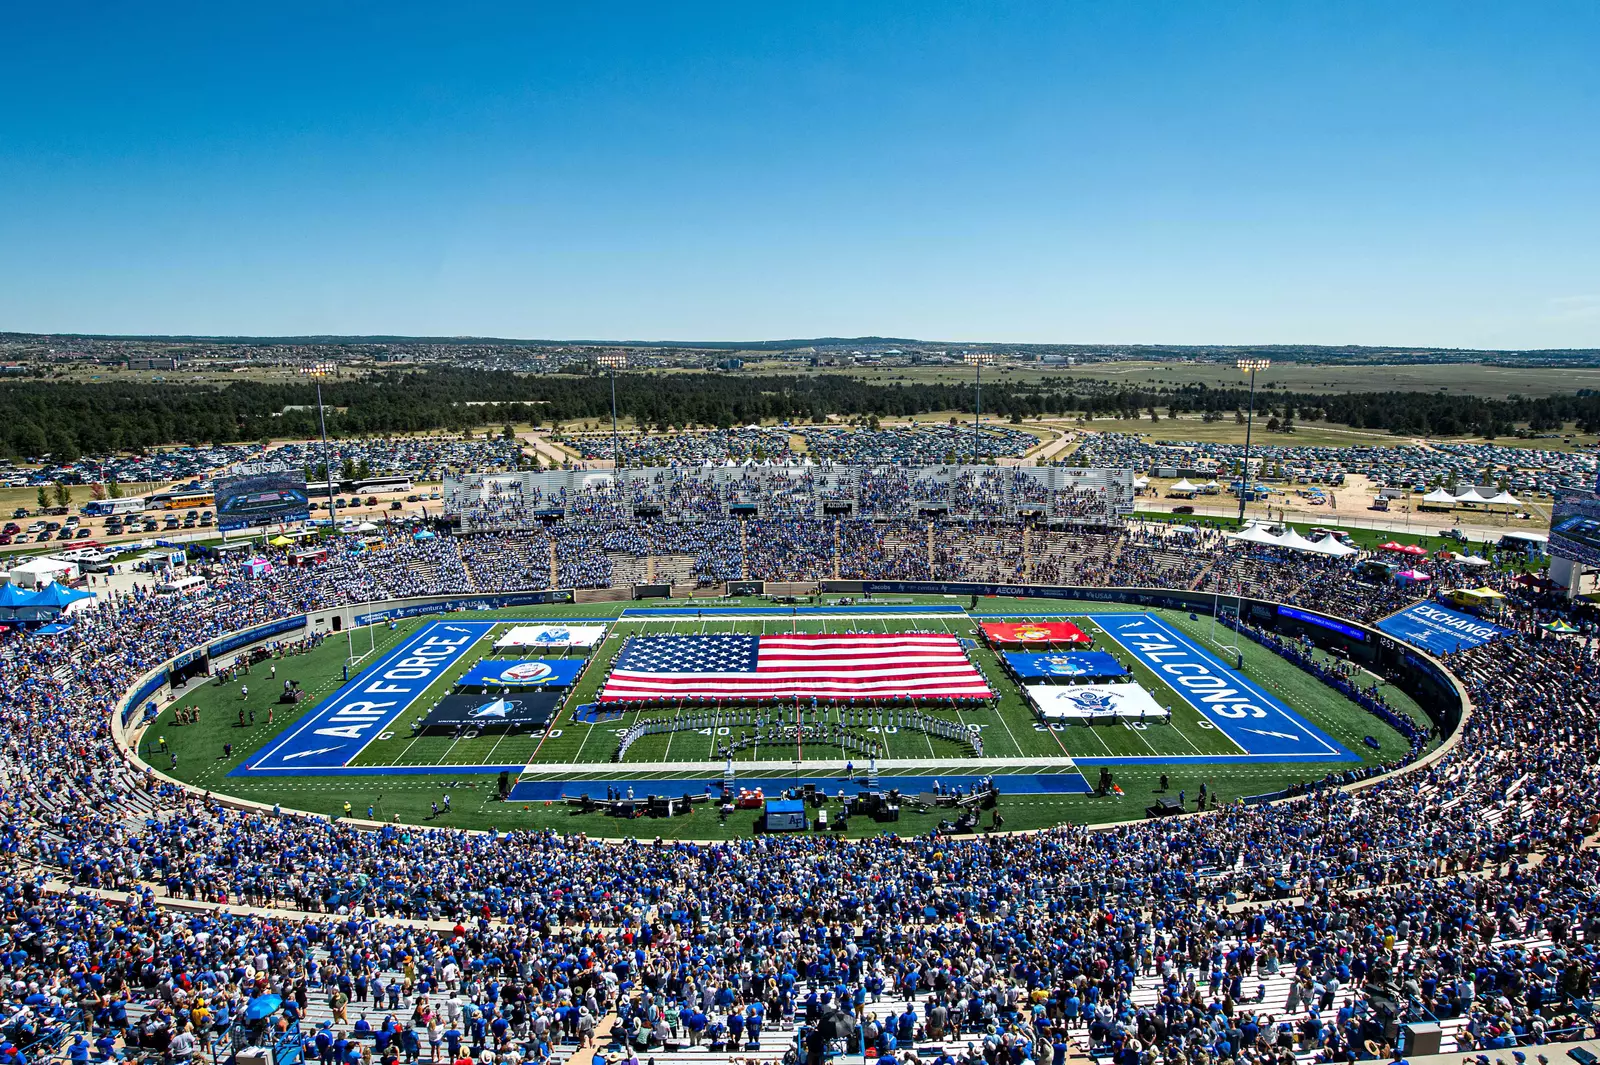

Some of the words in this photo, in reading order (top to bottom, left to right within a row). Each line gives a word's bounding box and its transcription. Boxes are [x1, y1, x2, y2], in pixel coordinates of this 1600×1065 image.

[251, 461, 287, 473] USAA
[996, 587, 1024, 595] AECOM
[418, 605, 443, 613] centura
[1412, 605, 1499, 640] EXCHANGE
[1121, 632, 1268, 719] FALCONS
[313, 701, 398, 739] AIR
[364, 635, 471, 693] FORCE
[698, 727, 731, 736] 40
[866, 726, 898, 734] 40
[1032, 722, 1065, 732] 20
[529, 729, 563, 738] 20
[788, 814, 803, 828] AF
